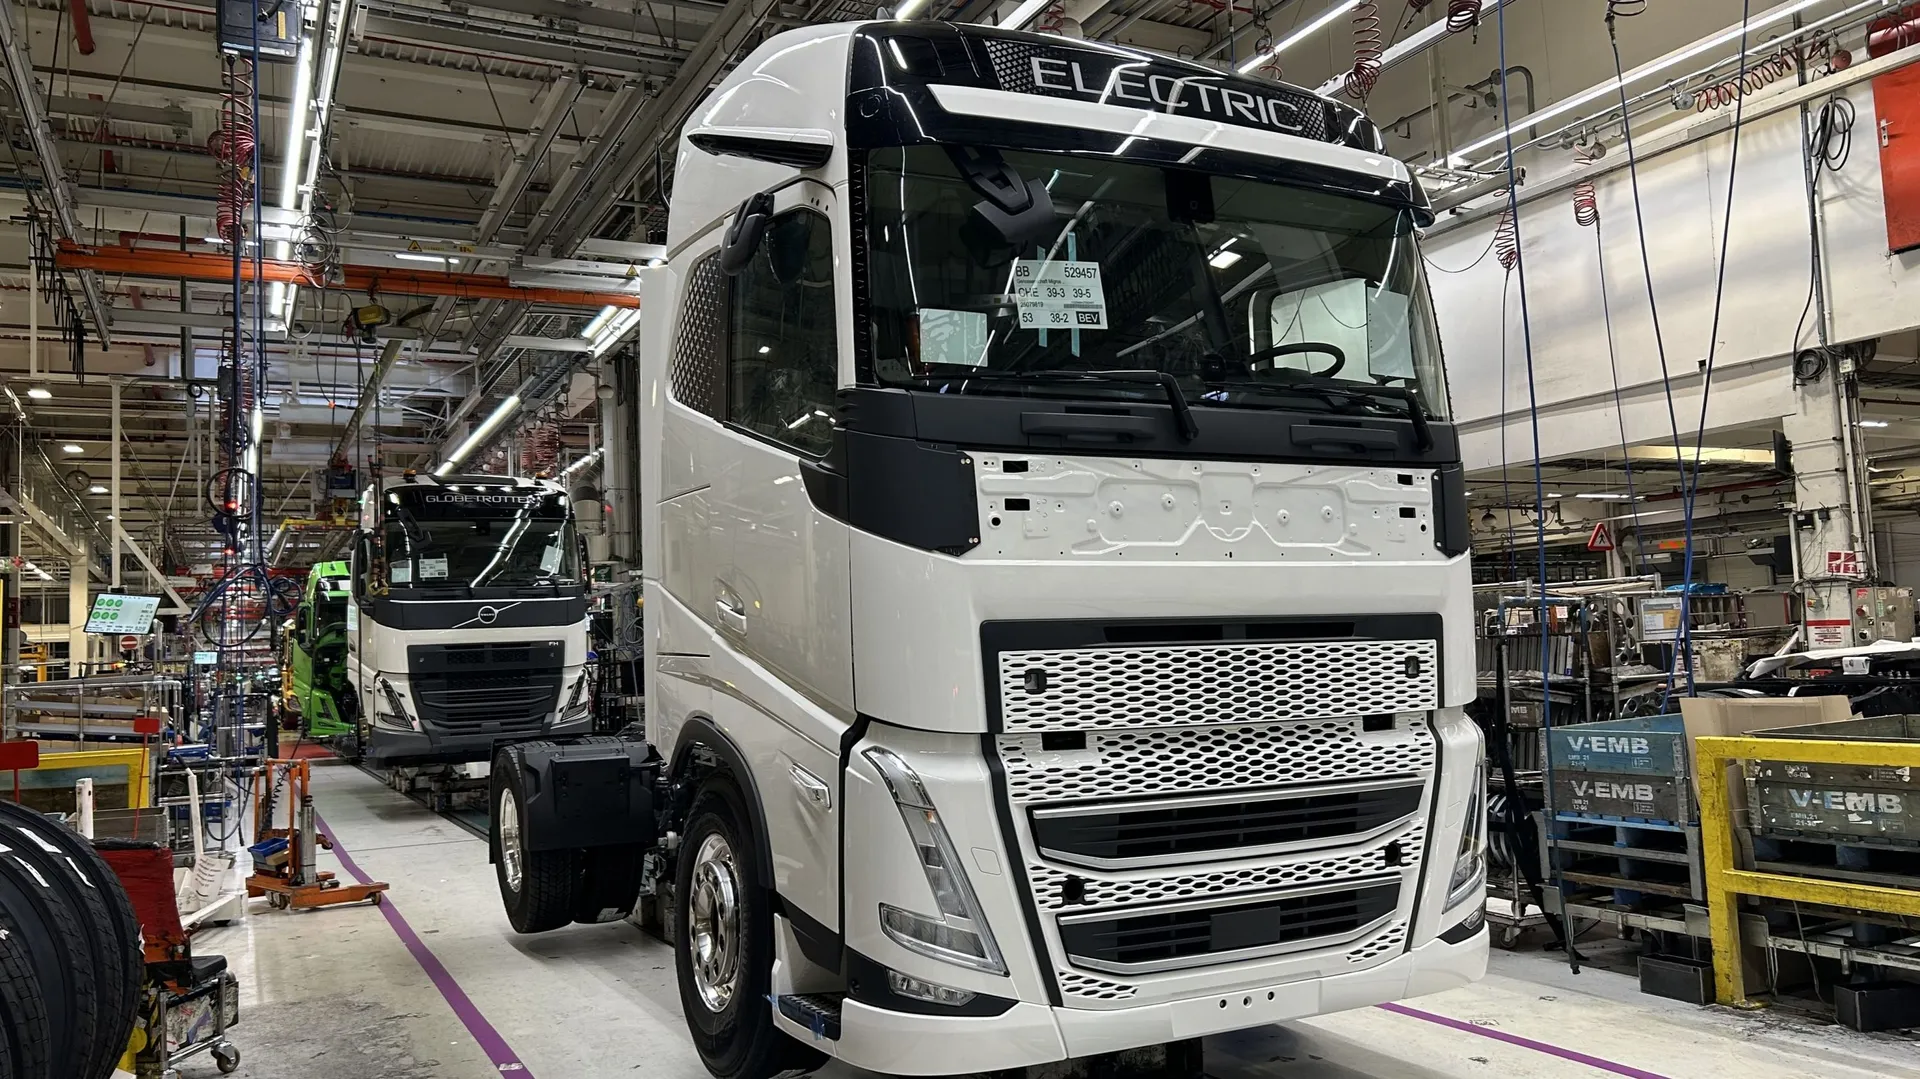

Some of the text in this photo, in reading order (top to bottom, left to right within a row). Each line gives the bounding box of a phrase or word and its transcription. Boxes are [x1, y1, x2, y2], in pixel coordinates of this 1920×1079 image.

[1031, 56, 1303, 132] ELECTRIC
[1015, 265, 1097, 279] BB 529457
[1018, 287, 1091, 299] CHE 39-3 39-5
[1022, 312, 1098, 323] 53 38-2 BEV
[1567, 736, 1649, 754] V-EMB
[1569, 780, 1654, 801] V-EMB
[1788, 788, 1903, 814] V-EMB
